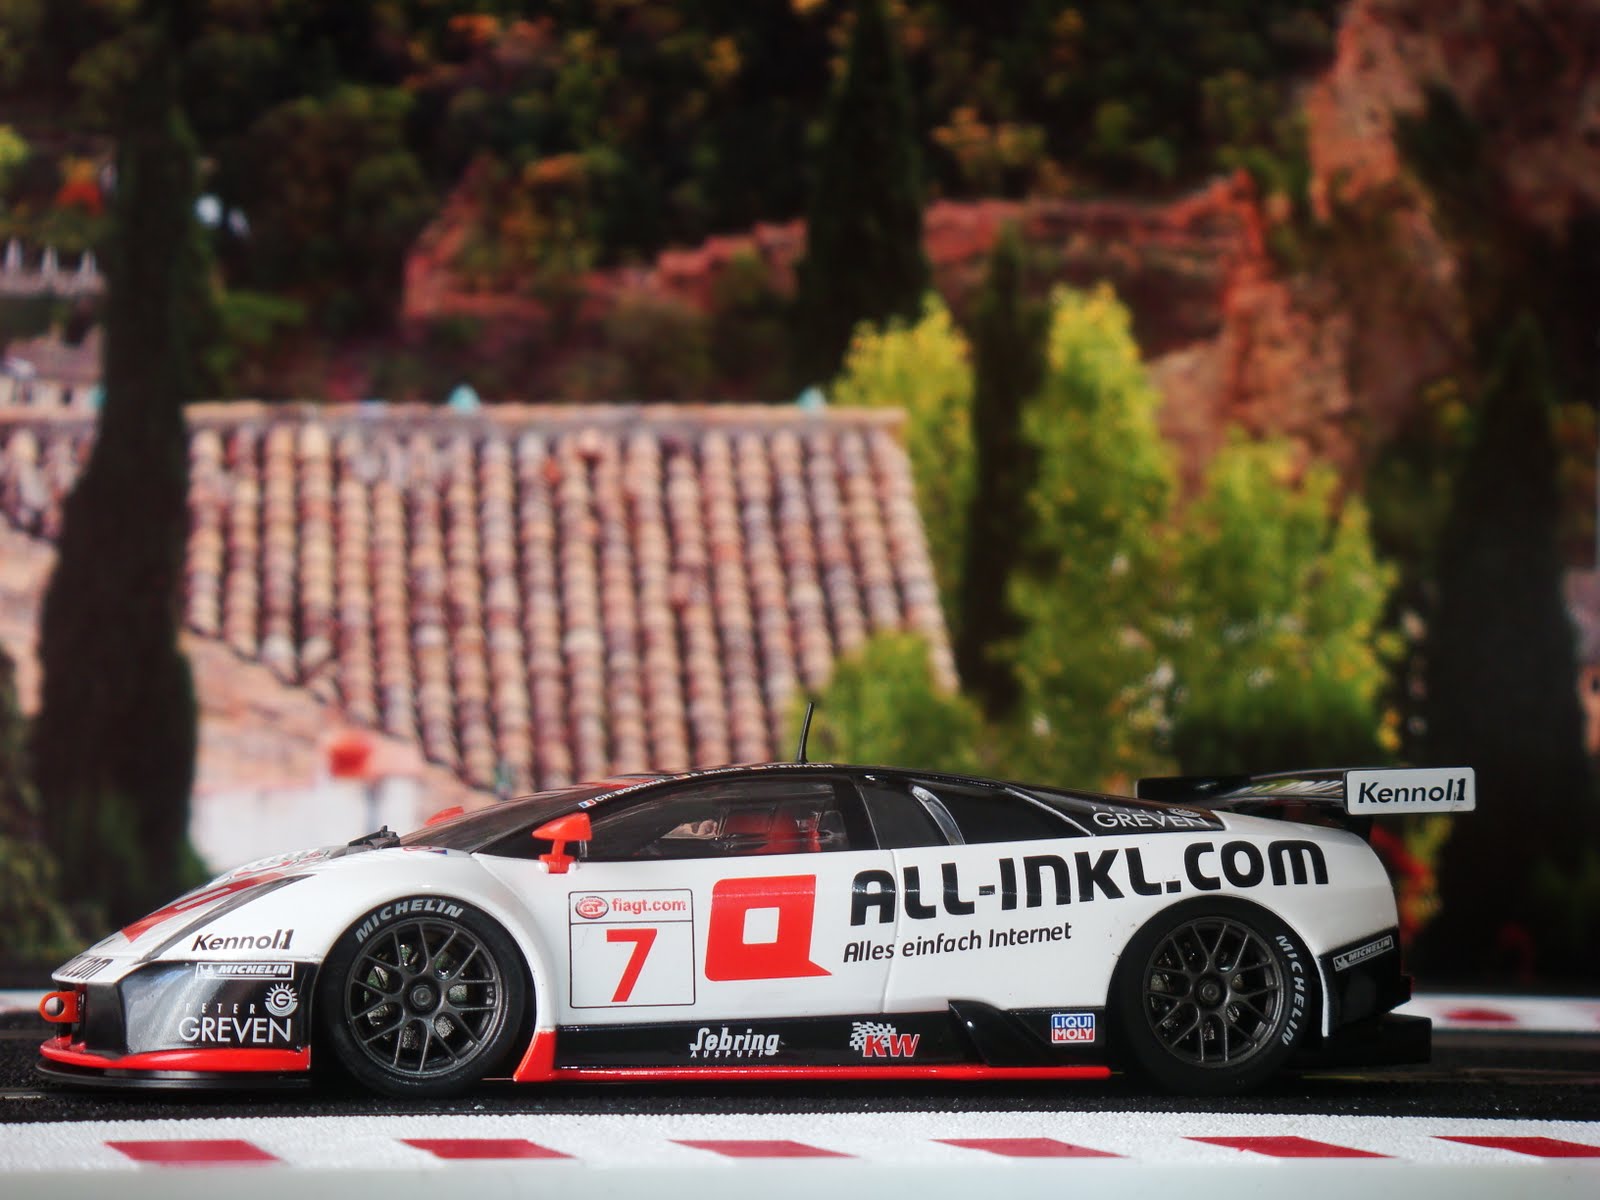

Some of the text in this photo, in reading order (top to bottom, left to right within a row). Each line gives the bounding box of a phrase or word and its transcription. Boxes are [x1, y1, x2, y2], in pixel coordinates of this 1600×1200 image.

[1092, 812, 1212, 828] GREVEN
[612, 898, 686, 915] fiagt.com
[355, 899, 464, 943] MICHELIN
[843, 922, 1072, 963] Alles einfach Internet
[1349, 938, 1390, 961] MICHELIN
[220, 965, 291, 974] MICHELIN
[606, 929, 657, 1002] 7
[1275, 935, 1305, 1046] MICHELIN
[185, 1003, 256, 1014] PETER
[178, 1016, 292, 1043] GREVEN
[1054, 1016, 1092, 1028] LIQUI
[689, 1027, 780, 1056] Sebring
[863, 1033, 920, 1057] KW
[1054, 1028, 1093, 1040] MOLY
[690, 1050, 764, 1058] AUSPUFF
